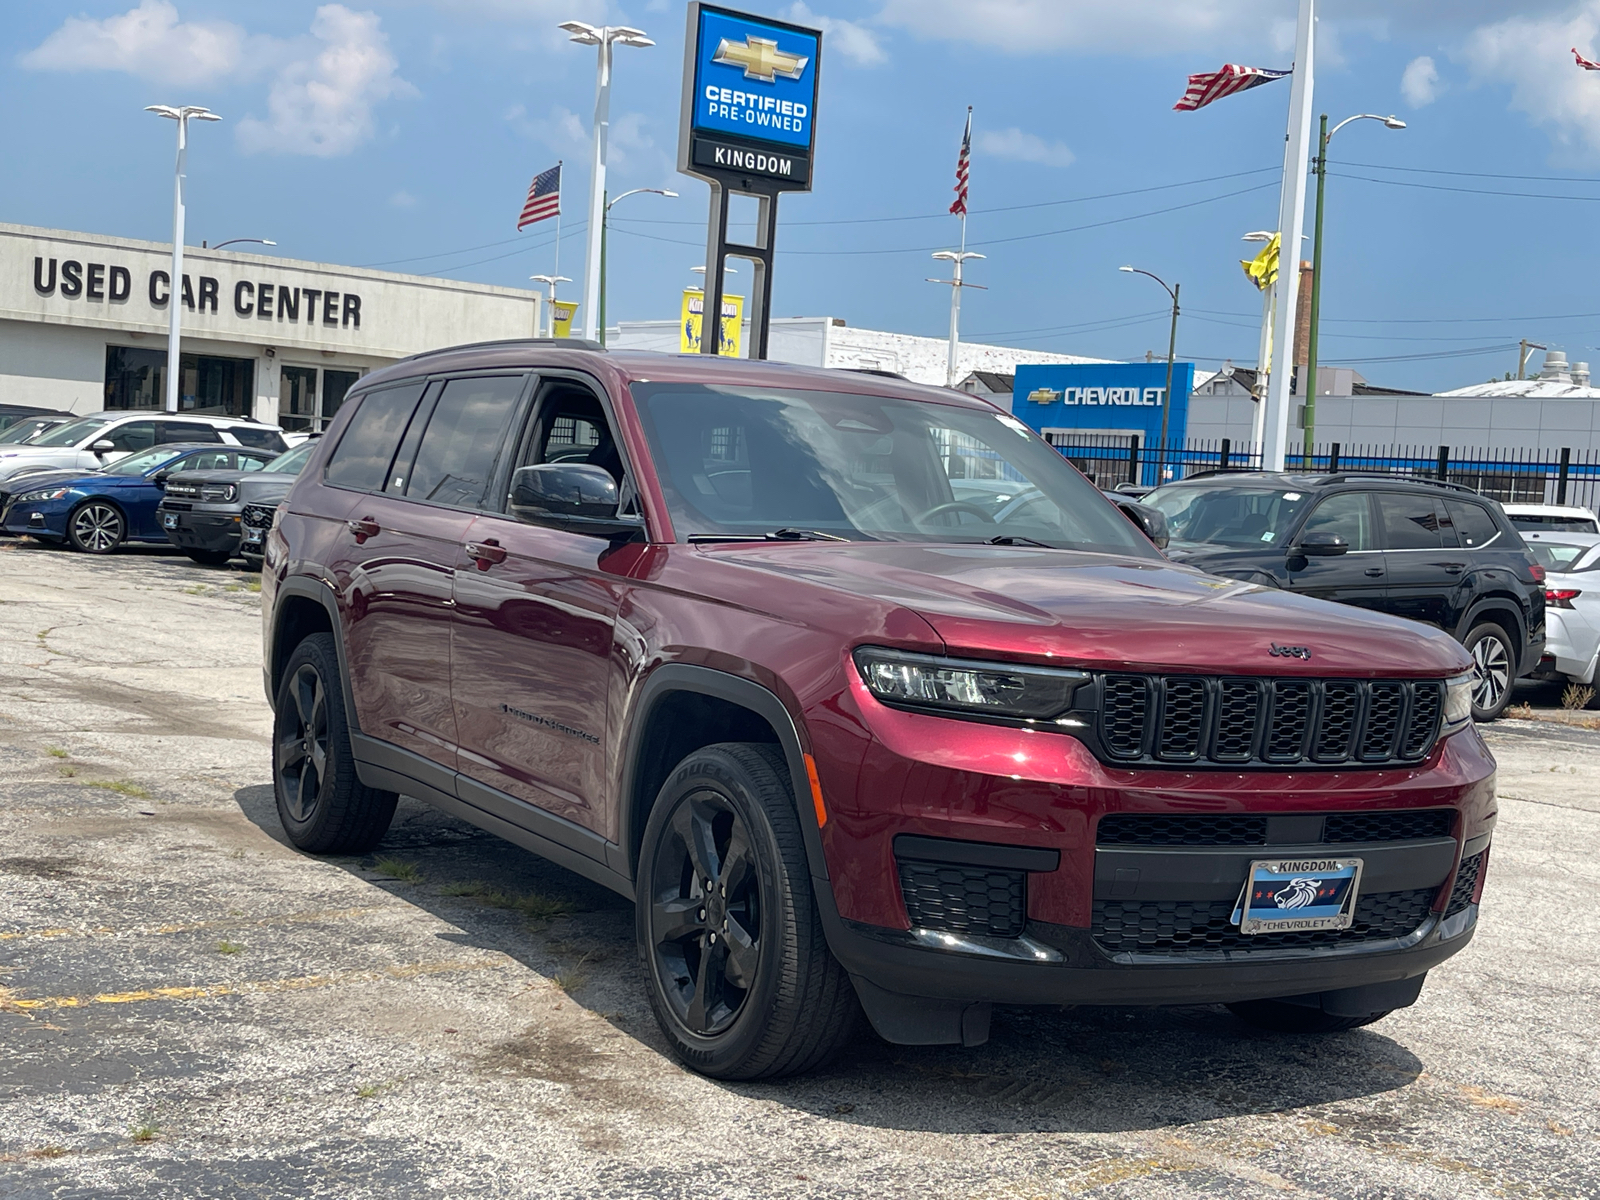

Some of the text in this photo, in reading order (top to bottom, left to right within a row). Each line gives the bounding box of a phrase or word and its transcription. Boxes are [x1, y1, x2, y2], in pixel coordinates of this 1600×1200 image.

[705, 85, 807, 118] CERTIFIED
[708, 102, 802, 133] PRE-OWNED
[714, 147, 792, 175] KINGDOM
[34, 256, 362, 327] USED CAR CENTER
[1064, 386, 1167, 406] CHEVROLET
[1268, 642, 1311, 661] Jeep
[1278, 860, 1337, 872] KINGDOM
[1266, 919, 1326, 930] CHEVROLET
